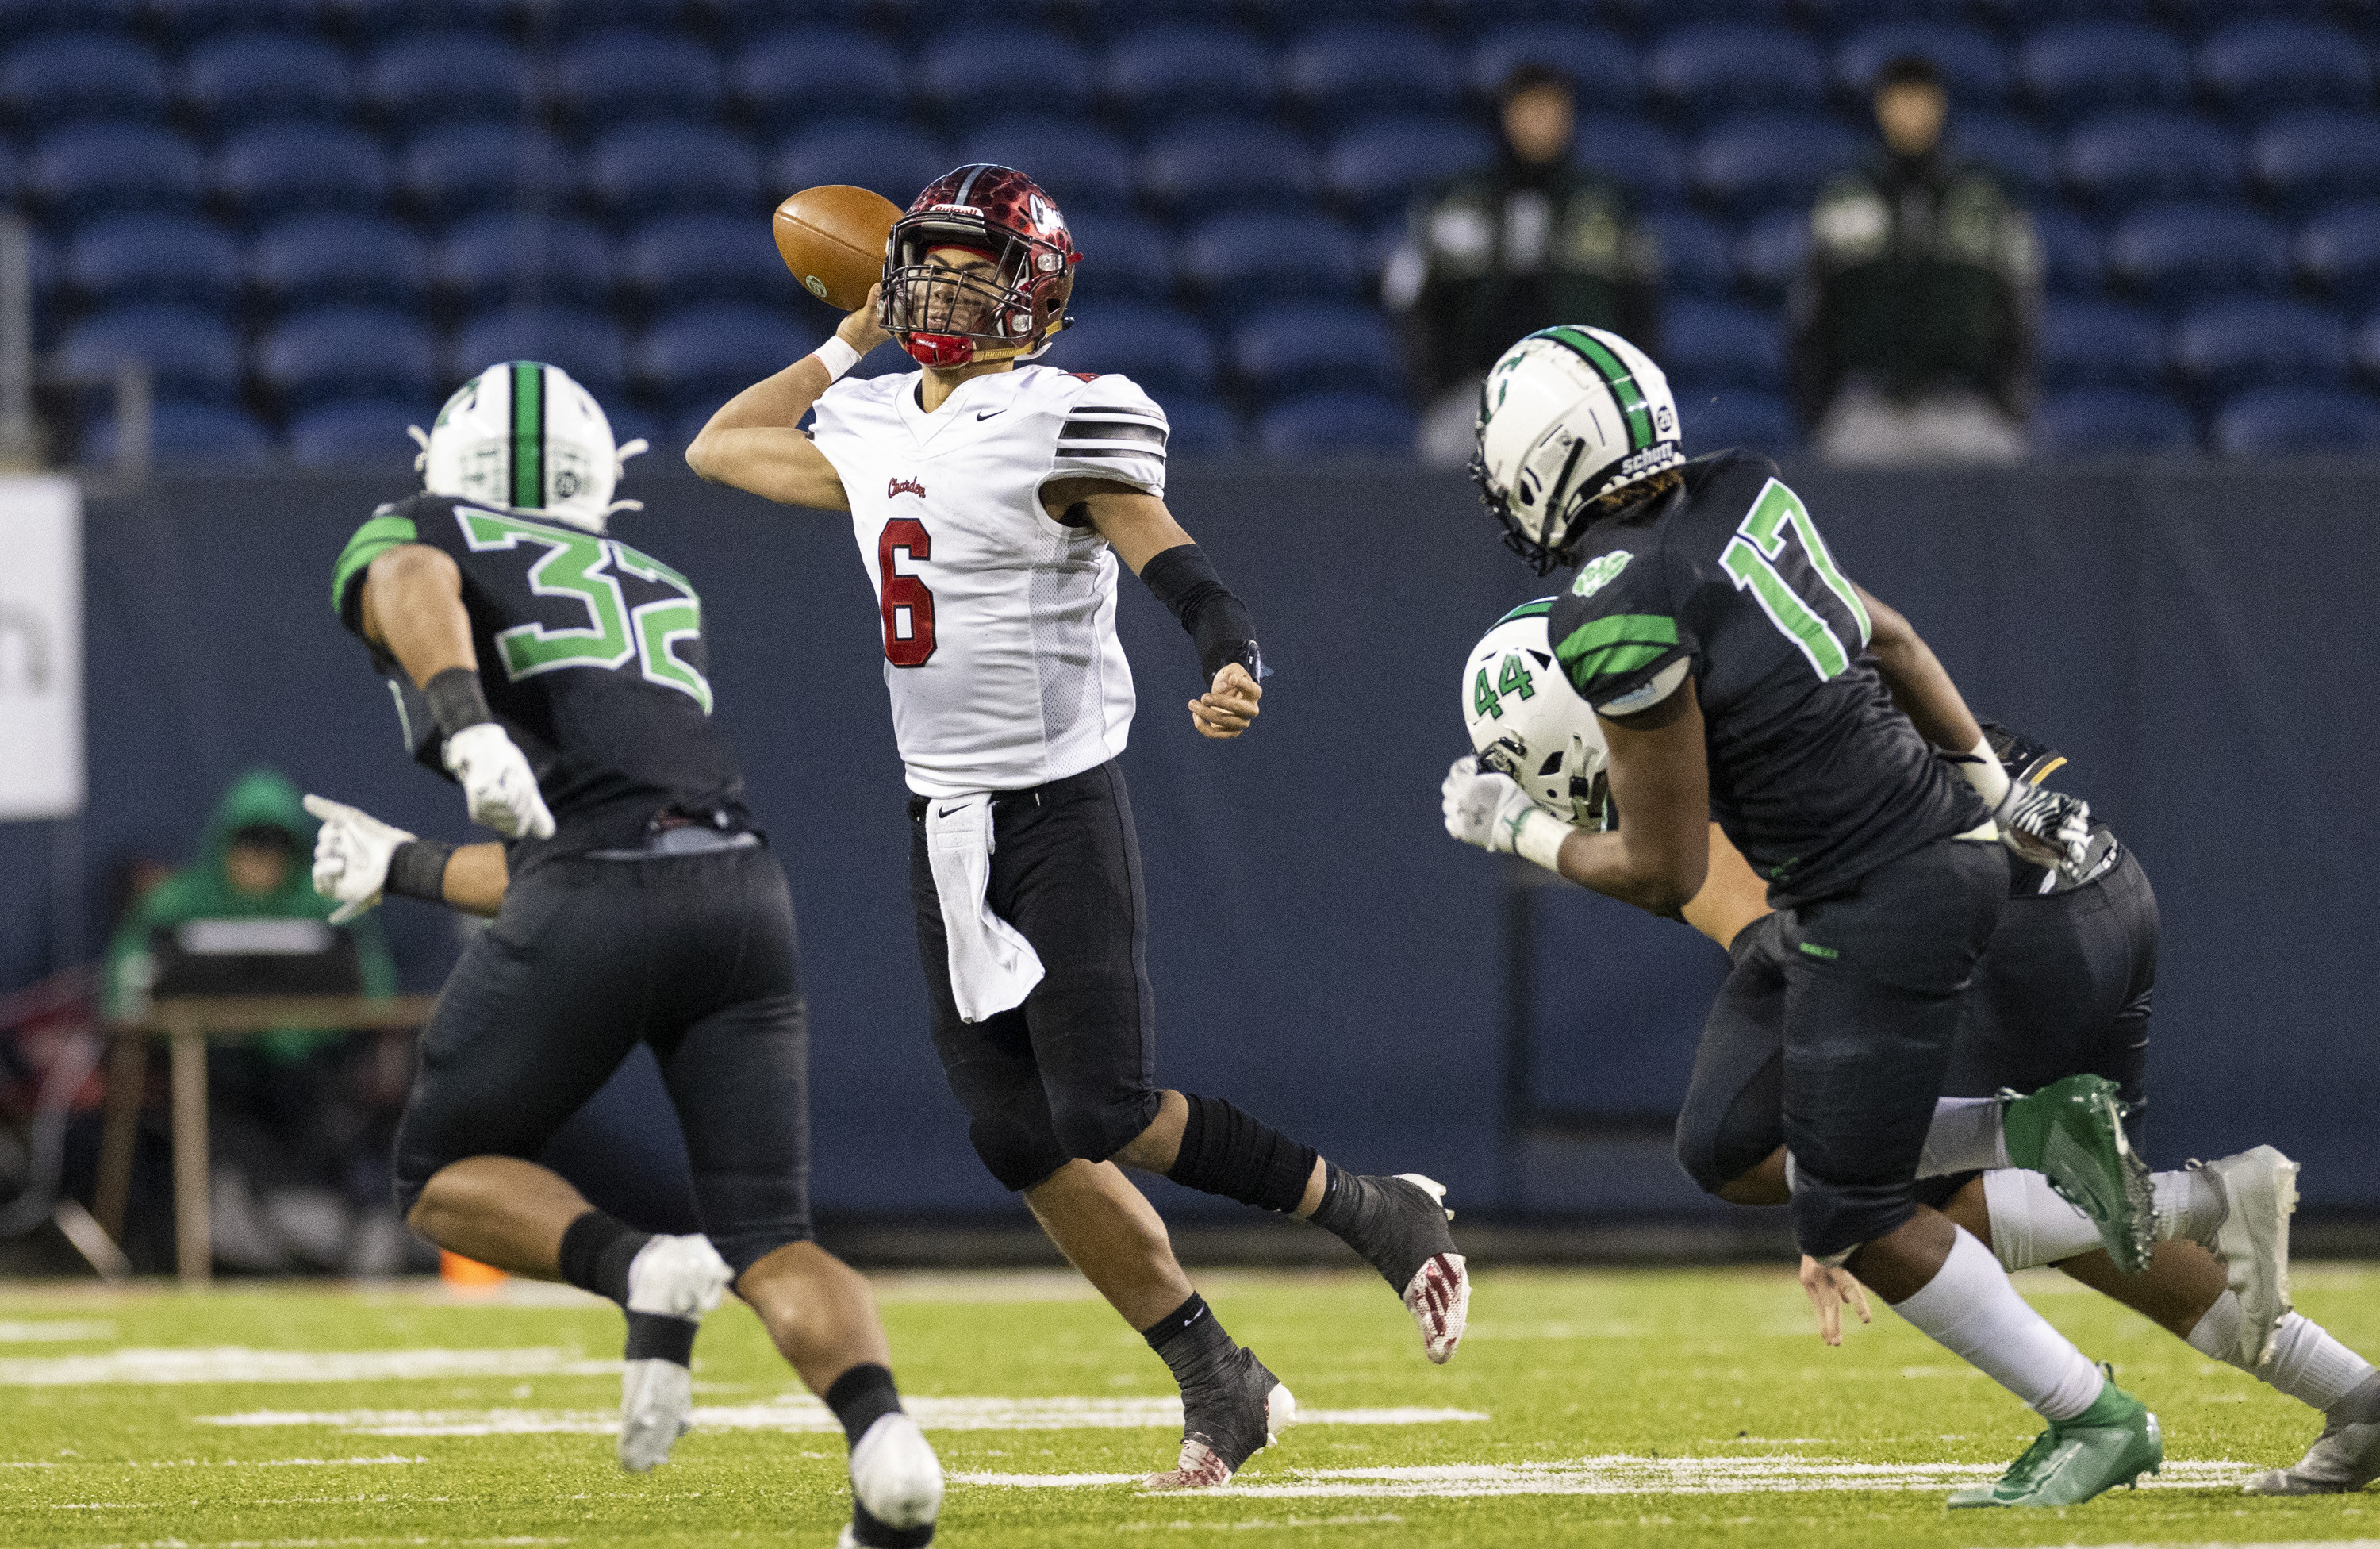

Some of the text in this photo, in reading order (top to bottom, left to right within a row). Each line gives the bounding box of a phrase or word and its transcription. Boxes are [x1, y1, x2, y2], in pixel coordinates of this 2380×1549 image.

[888, 476, 926, 498] Chardon
[454, 505, 713, 716] 32
[878, 517, 937, 667] 6
[1719, 477, 1871, 681] 17
[1474, 653, 1535, 720] 44
